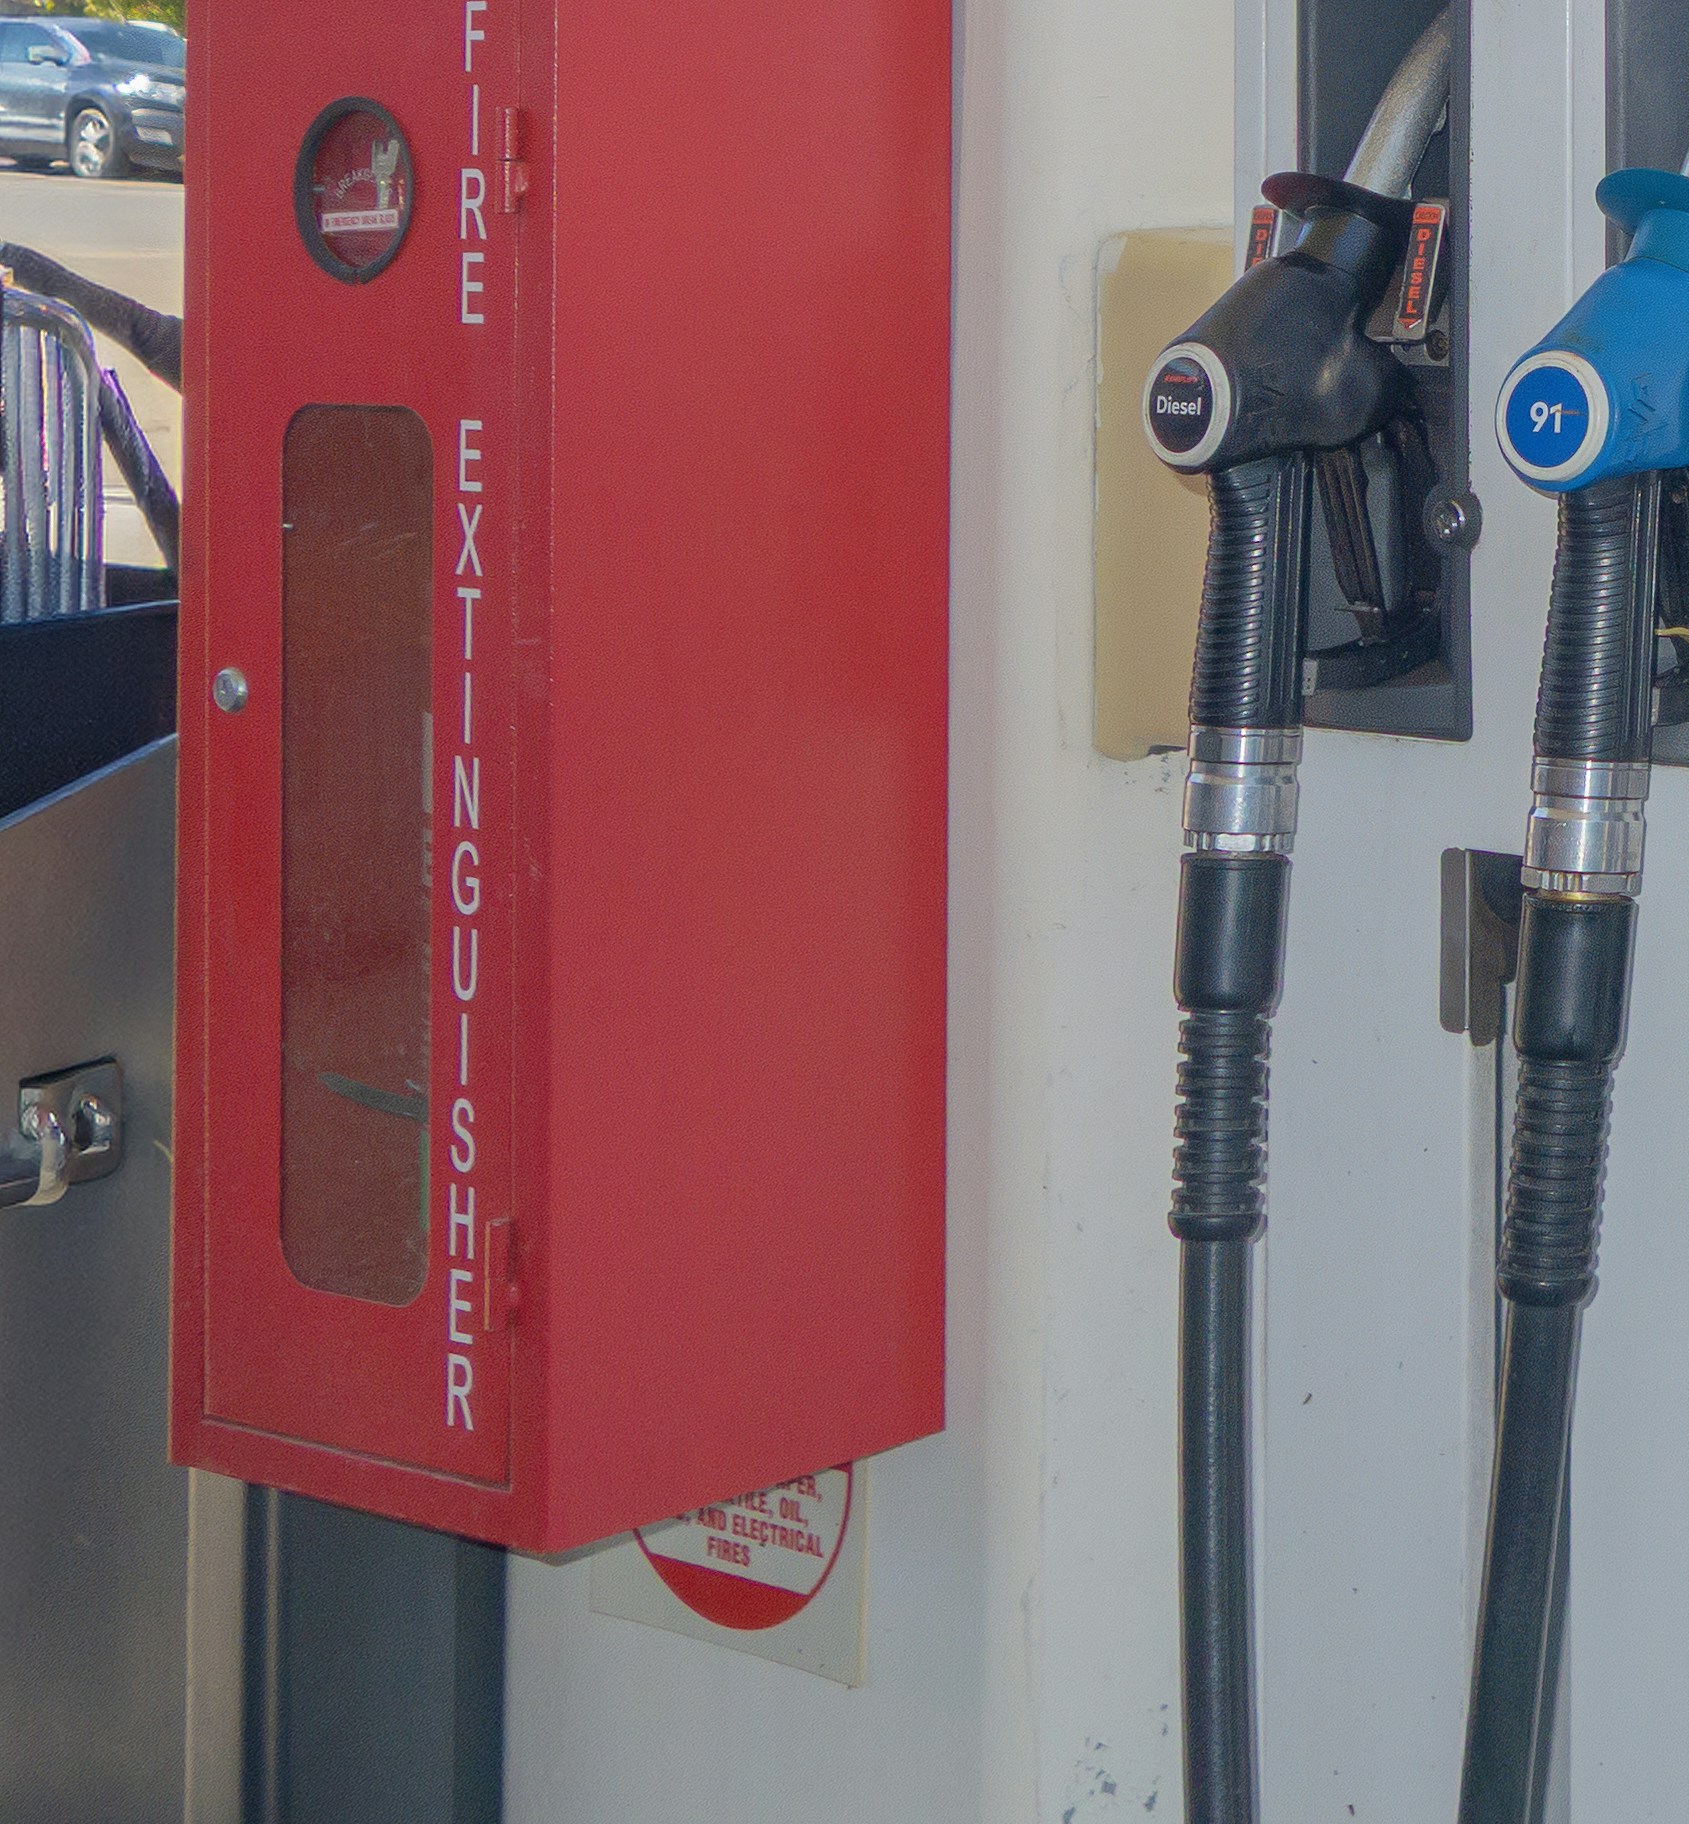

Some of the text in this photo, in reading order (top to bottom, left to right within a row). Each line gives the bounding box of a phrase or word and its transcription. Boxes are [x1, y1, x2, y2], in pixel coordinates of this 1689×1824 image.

[1406, 228, 1431, 314] DIESEL
[1157, 395, 1202, 416] Diesel
[1530, 401, 1563, 434] 91
[446, 0, 487, 1431] FIRE EXTINGUISHER
